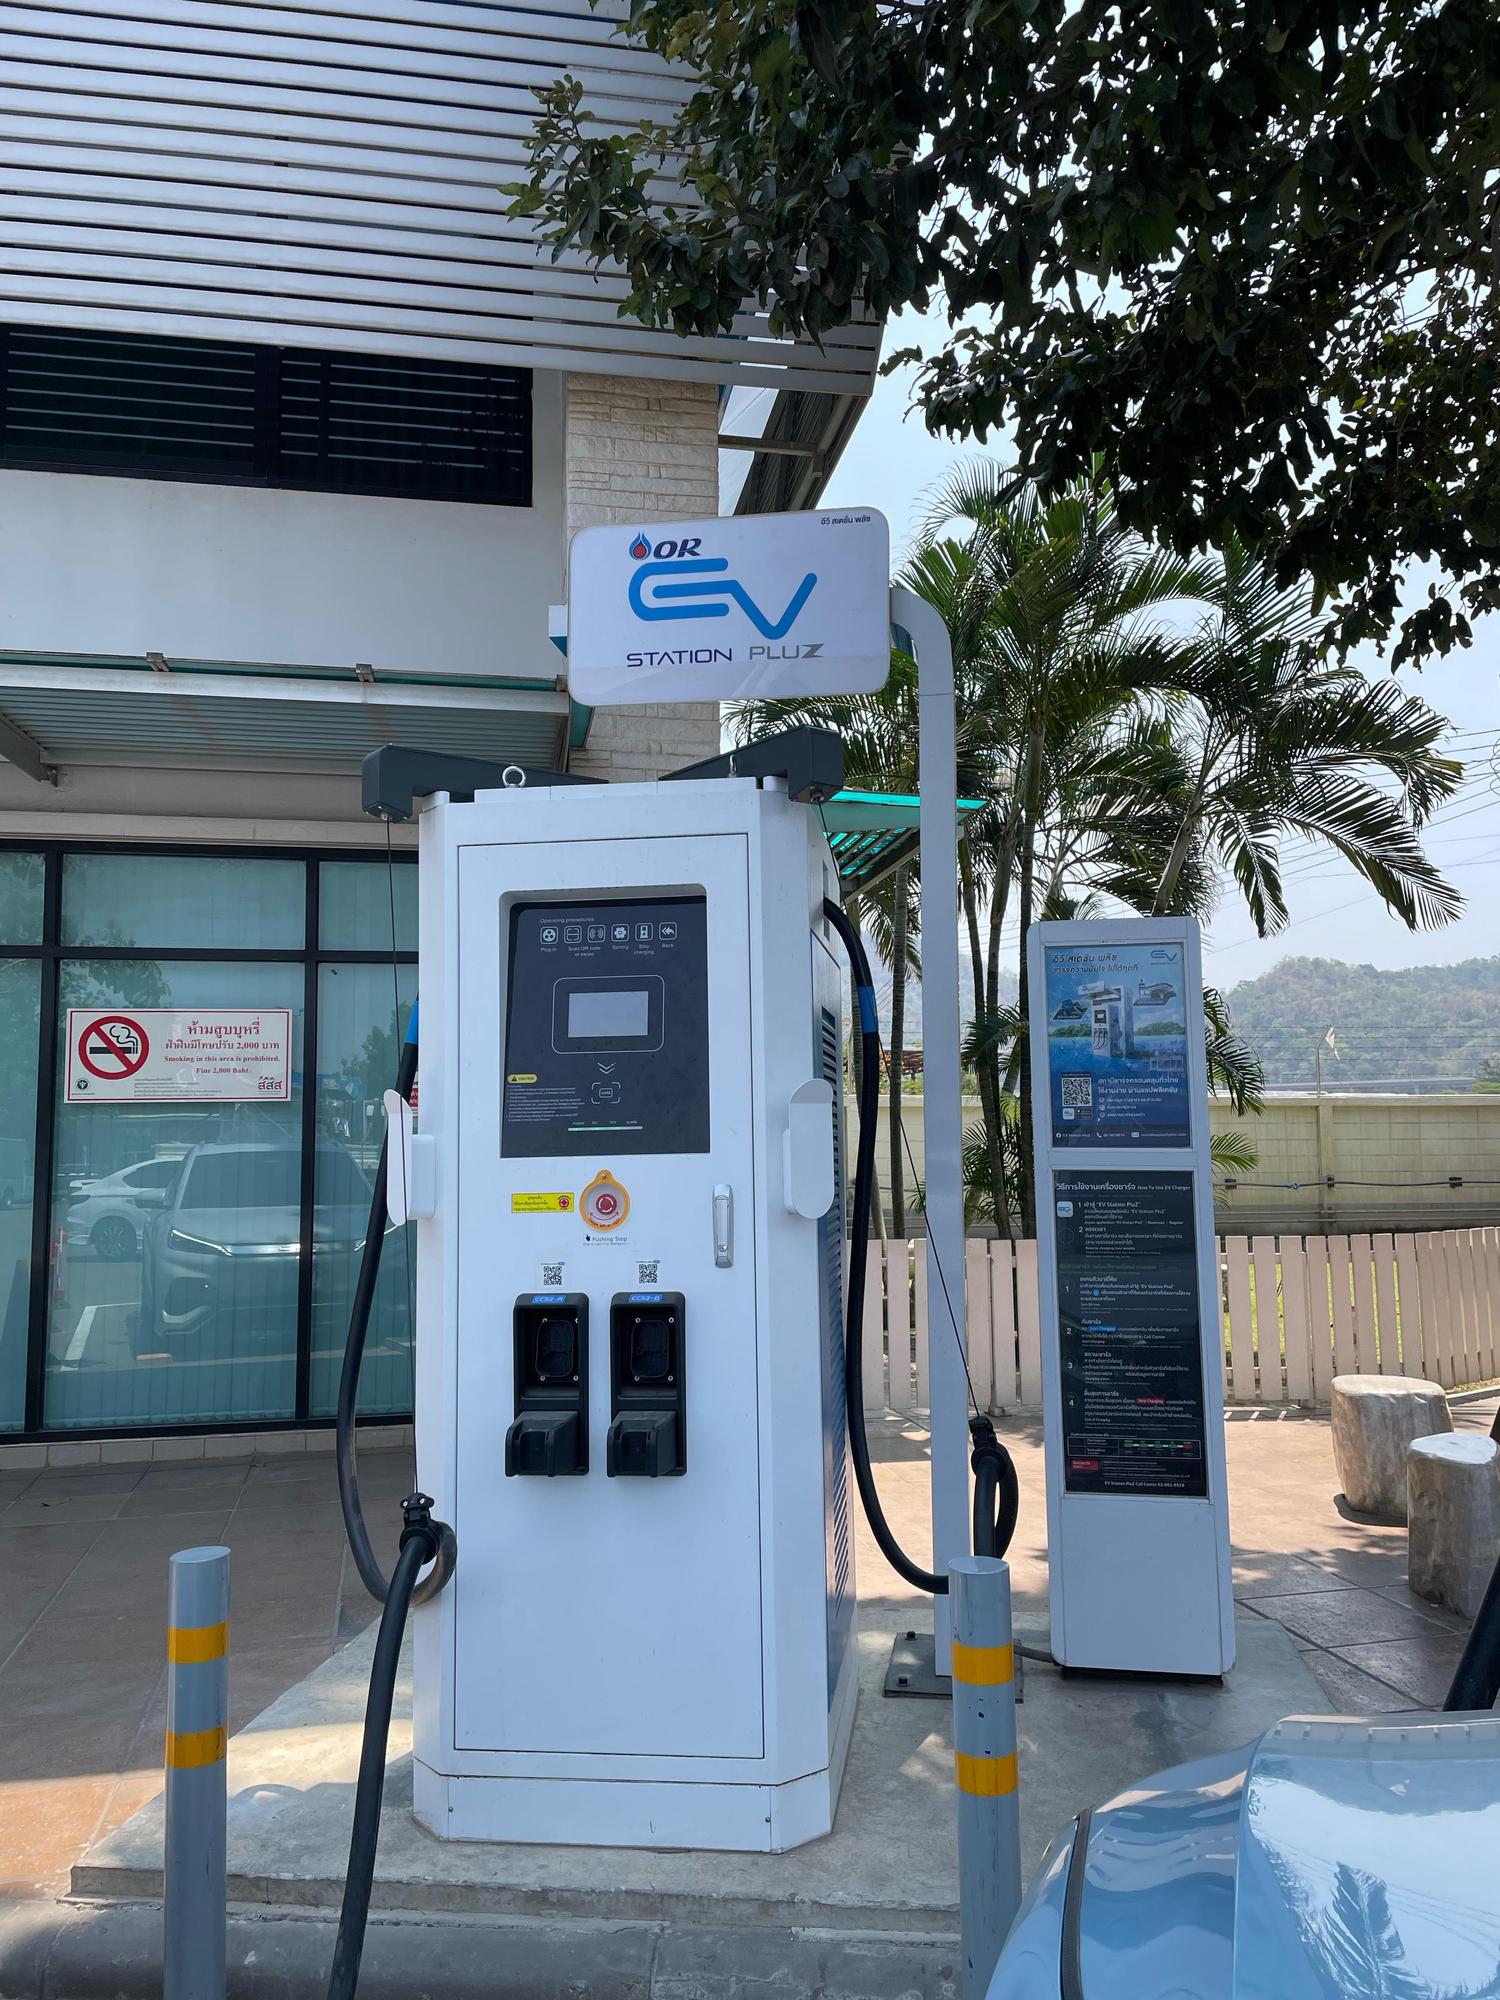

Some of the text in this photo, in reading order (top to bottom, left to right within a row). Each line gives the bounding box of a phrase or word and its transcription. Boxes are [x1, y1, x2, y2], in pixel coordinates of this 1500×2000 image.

[653, 537, 702, 559] OR
[628, 557, 818, 640] EV
[627, 643, 825, 667] STATION PLUZ
[1150, 949, 1178, 962] EV
[187, 1016, 261, 1039] ห้ามสูบบุหรี่
[165, 1039, 280, 1050] ฝ่าฝืนมีโทษปรับ 2,000 บาท
[164, 1055, 195, 1063] Smoking
